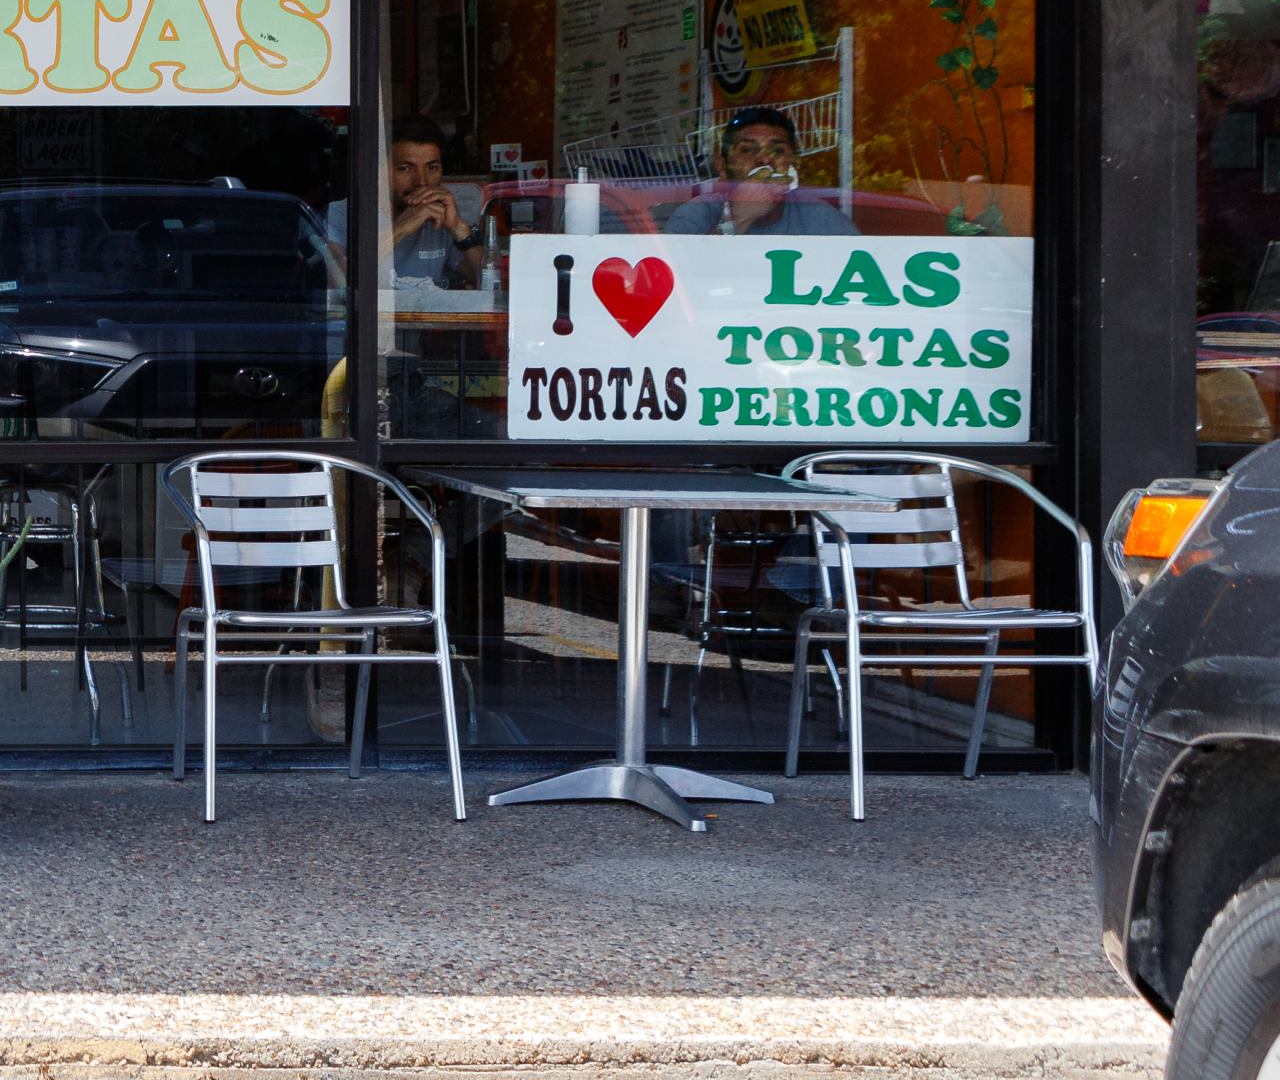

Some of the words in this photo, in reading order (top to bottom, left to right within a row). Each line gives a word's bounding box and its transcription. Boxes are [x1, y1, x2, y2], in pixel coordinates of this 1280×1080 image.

[552, 254, 574, 336] I
[764, 249, 961, 308] LAS
[717, 325, 1010, 369] TORTAS
[522, 366, 687, 422] TORTAS
[699, 386, 1022, 430] PERRONAS
